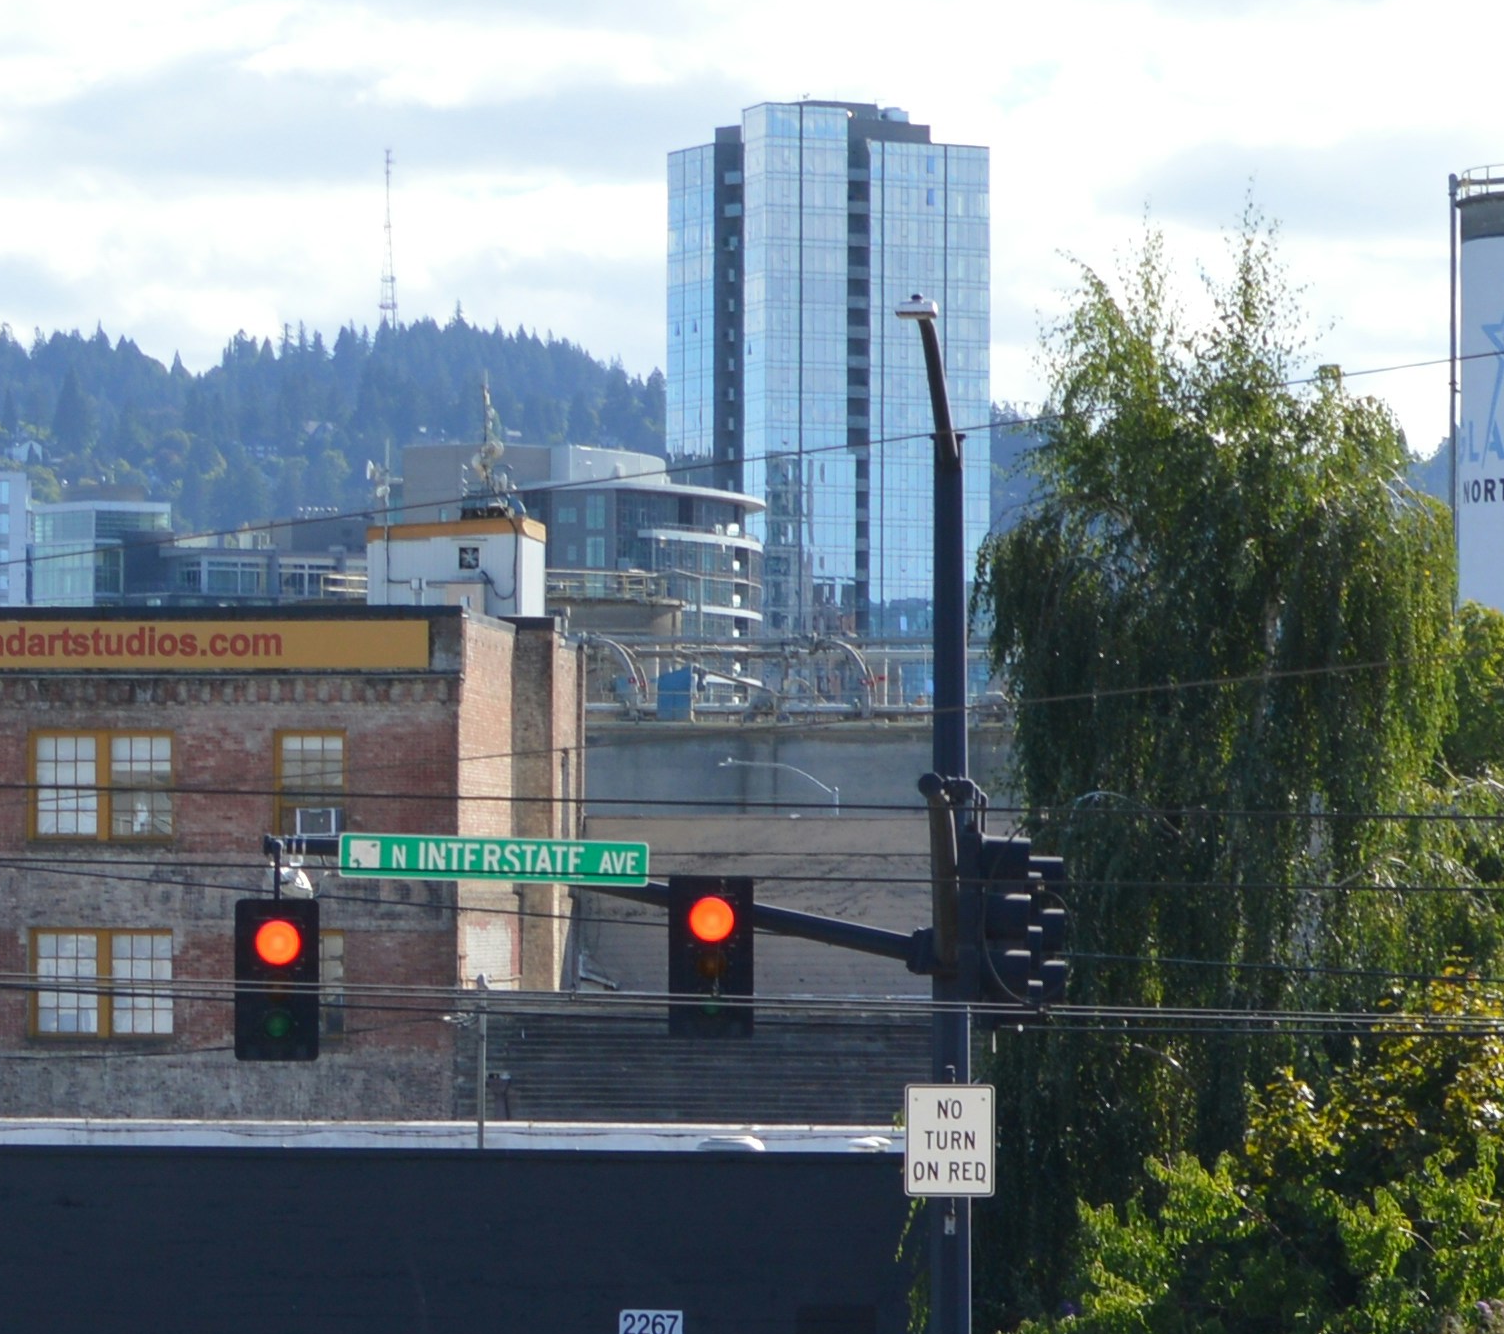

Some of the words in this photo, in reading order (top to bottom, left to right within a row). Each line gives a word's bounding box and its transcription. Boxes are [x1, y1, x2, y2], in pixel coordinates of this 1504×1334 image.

[392, 844, 406, 869] N
[418, 841, 585, 879] INTERSTATE
[598, 850, 640, 876] AVE
[937, 1100, 962, 1119] NO
[924, 1130, 975, 1150] TURN
[913, 1161, 938, 1181] ON
[949, 1161, 986, 1182] RED
